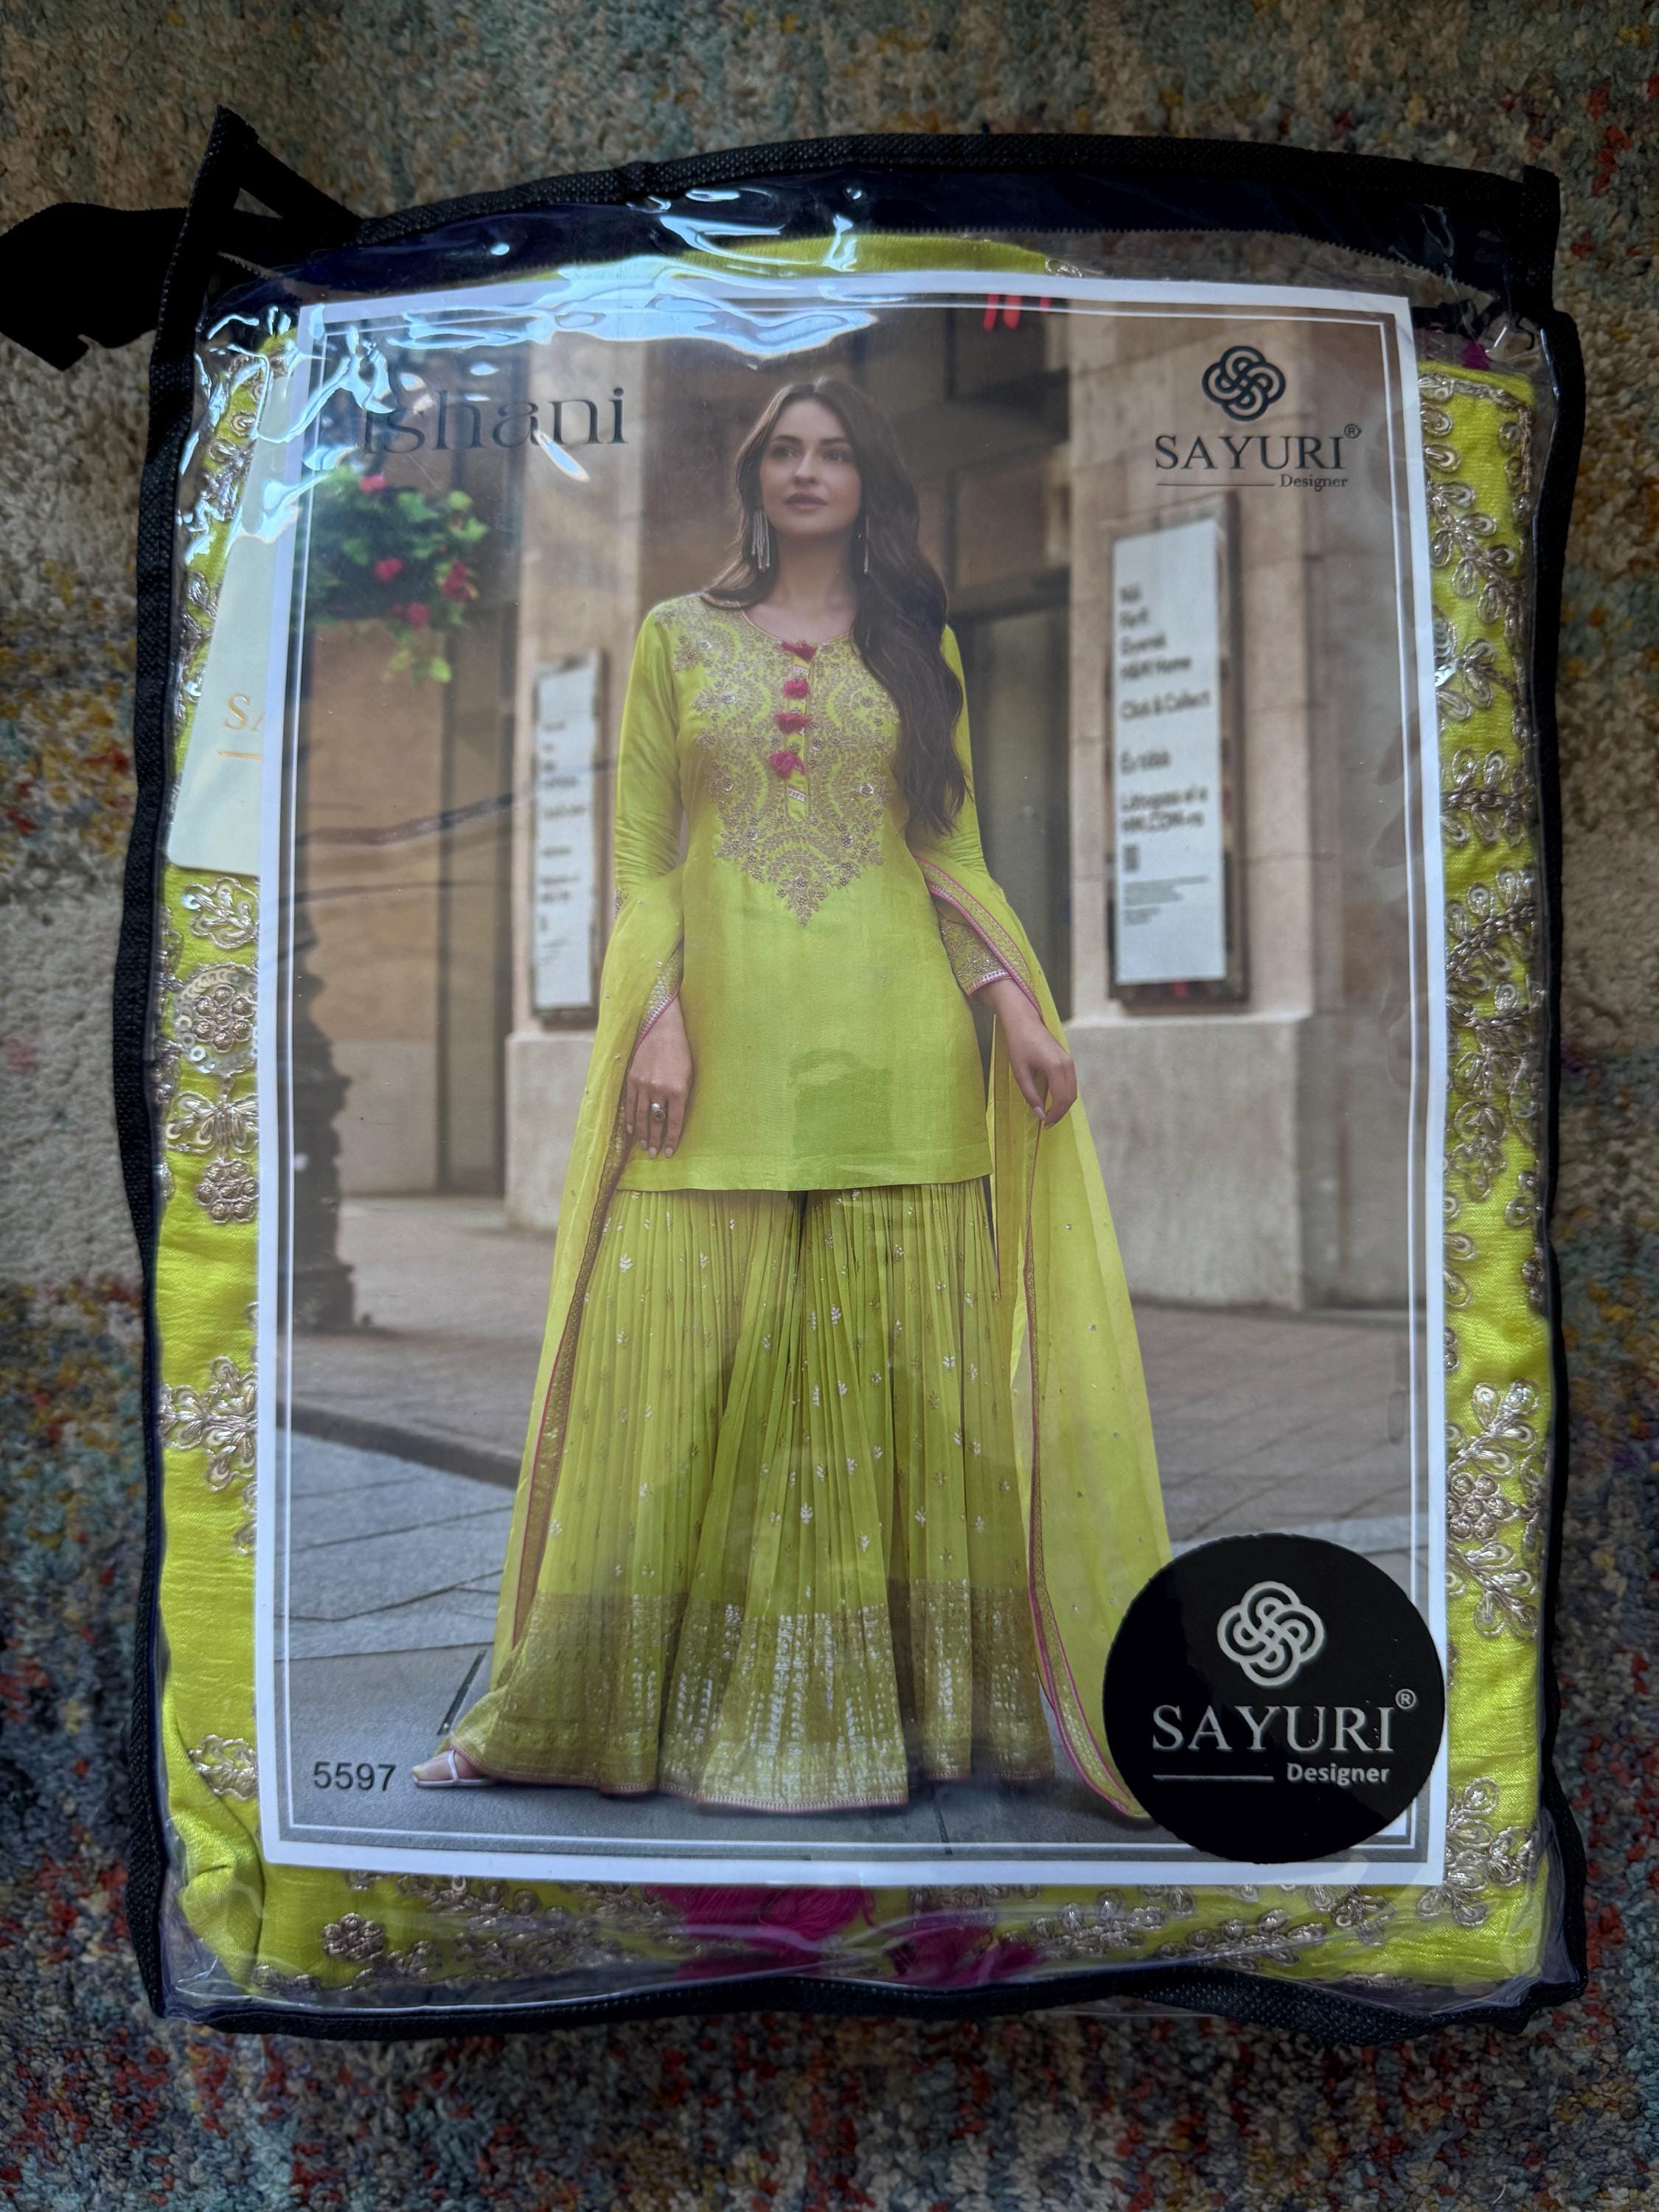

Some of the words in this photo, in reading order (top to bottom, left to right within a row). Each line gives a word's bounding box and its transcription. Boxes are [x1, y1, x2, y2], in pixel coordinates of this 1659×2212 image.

[1280, 473, 1349, 493] Designer
[313, 1760, 397, 1792] 5597
[1287, 1762, 1391, 1787] Designer
